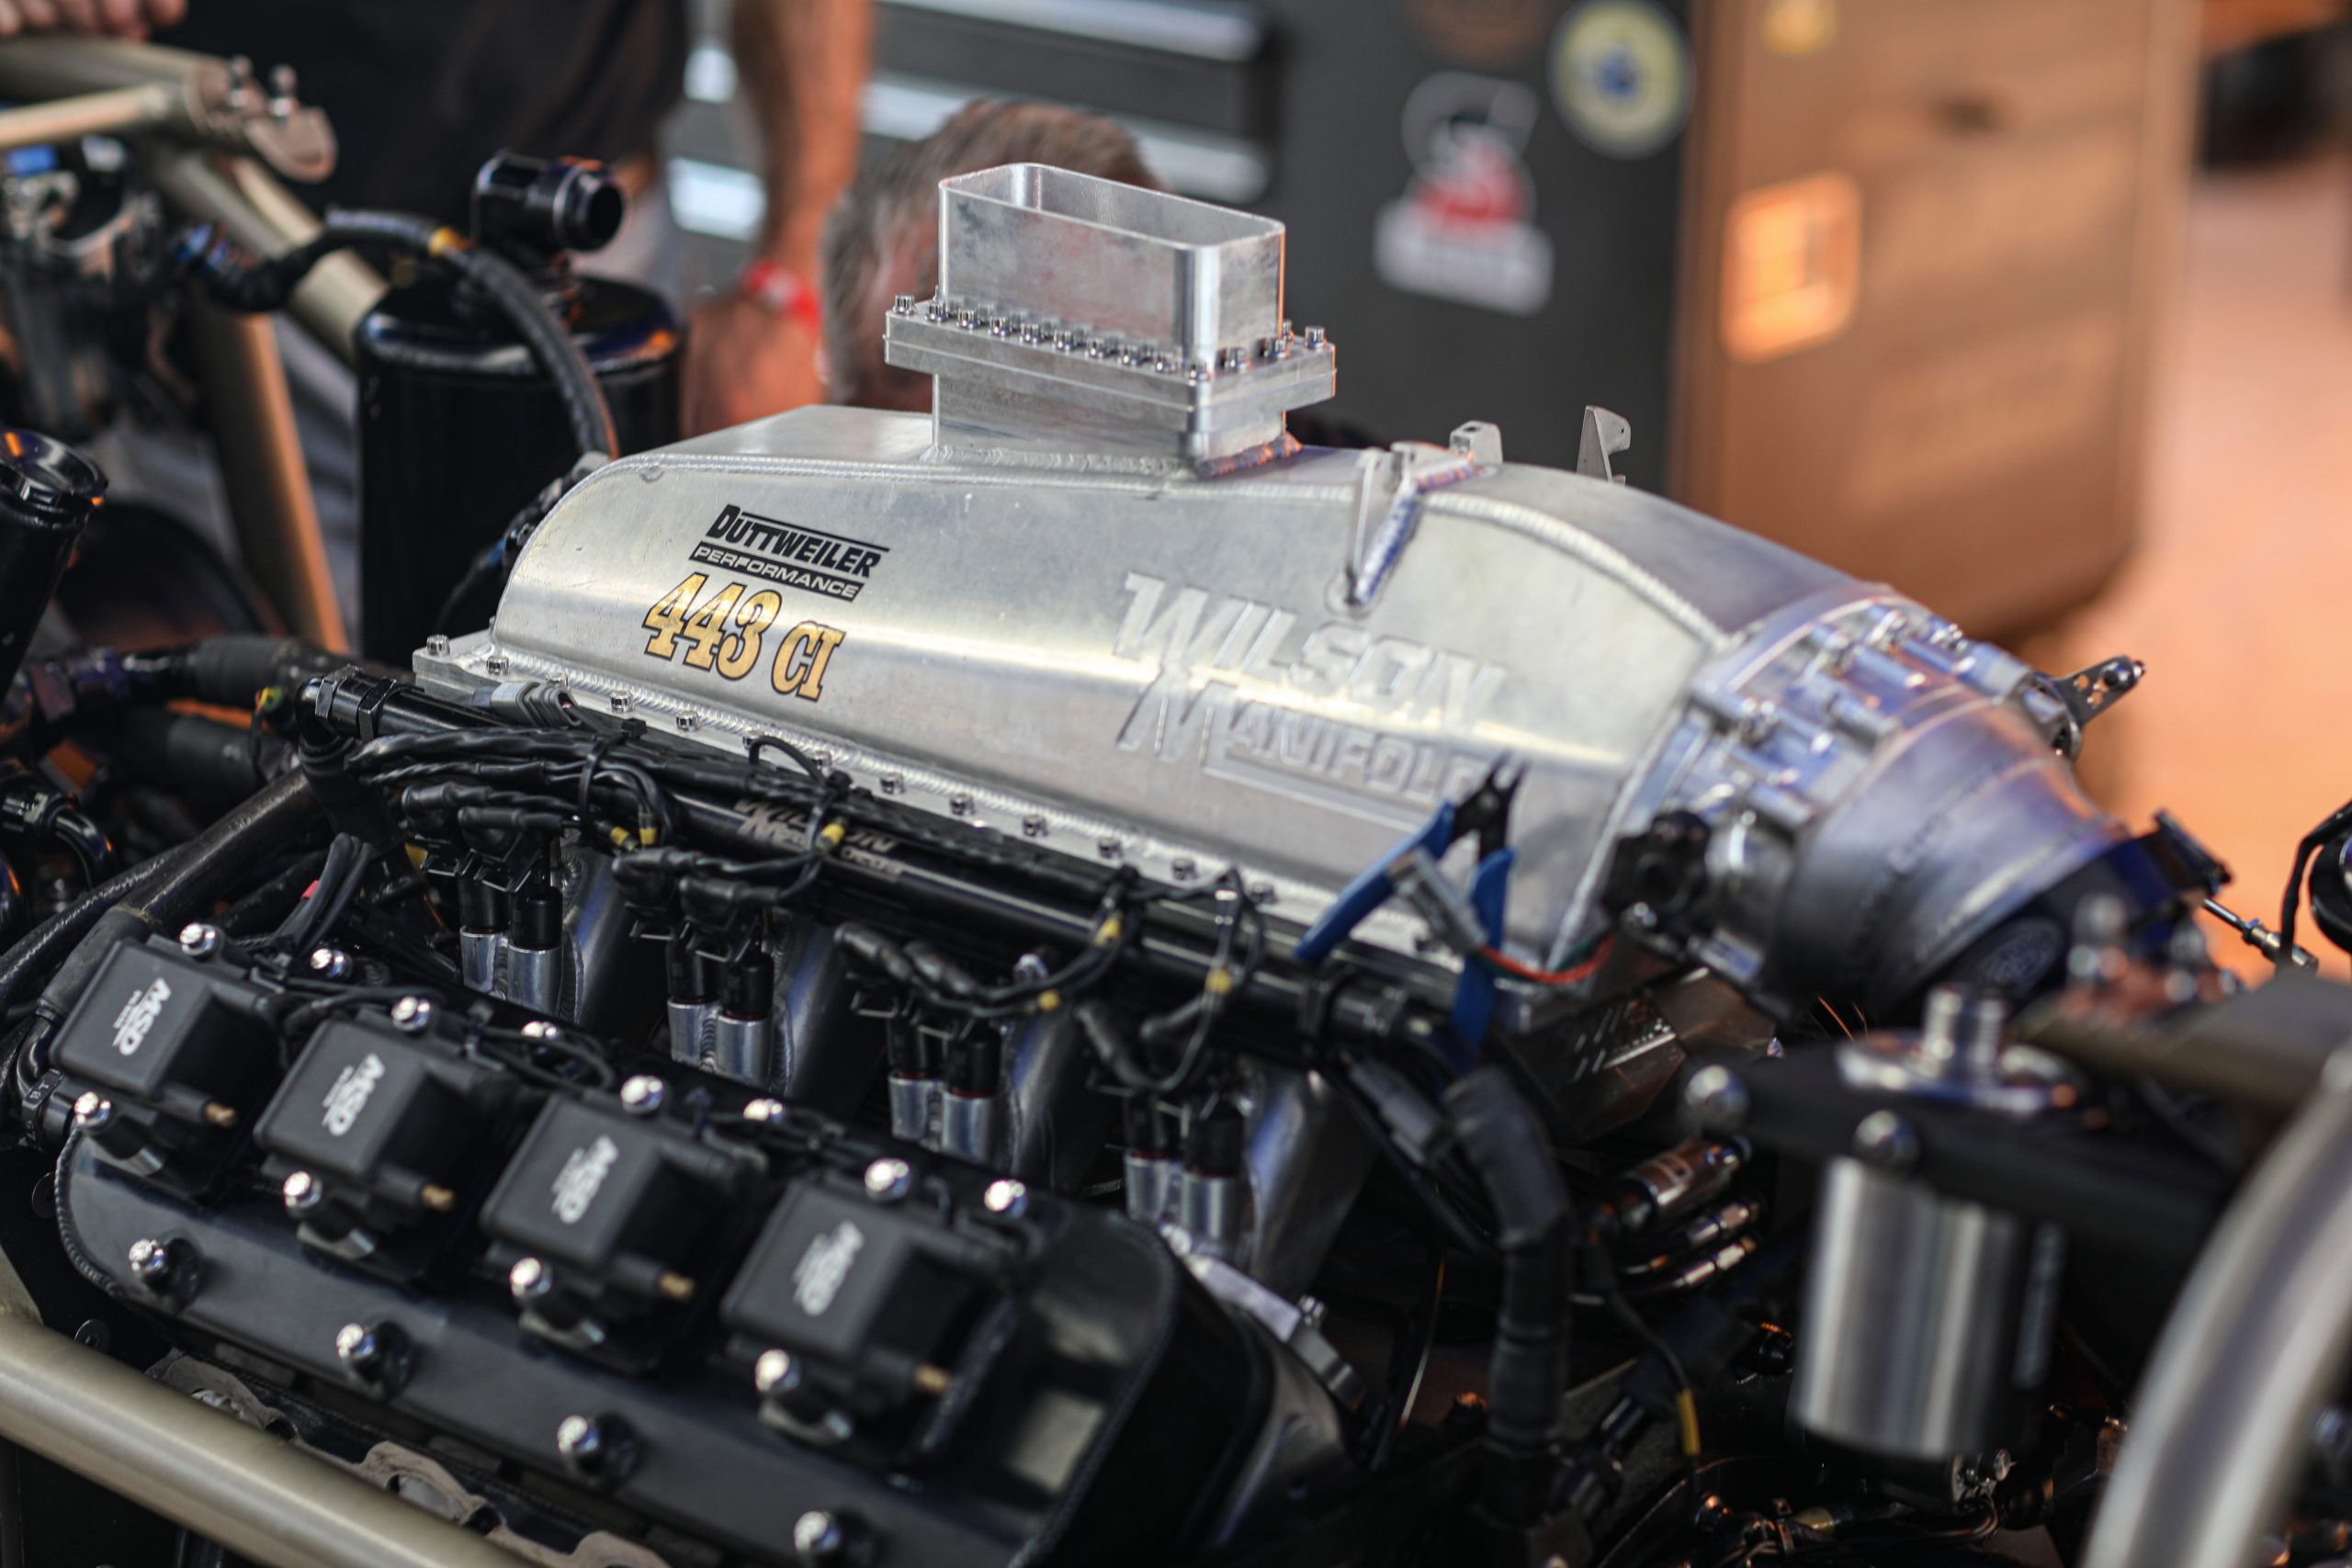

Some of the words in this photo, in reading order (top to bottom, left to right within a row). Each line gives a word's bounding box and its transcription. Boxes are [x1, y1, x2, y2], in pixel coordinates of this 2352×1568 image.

[694, 546, 860, 598] PERFORMANCE
[706, 504, 882, 579] DUTTWEILER
[641, 571, 783, 682] 443
[770, 619, 847, 702] CI
[1113, 571, 1507, 728] WILSON
[118, 977, 172, 1056] MSD
[328, 1053, 386, 1136] MSD
